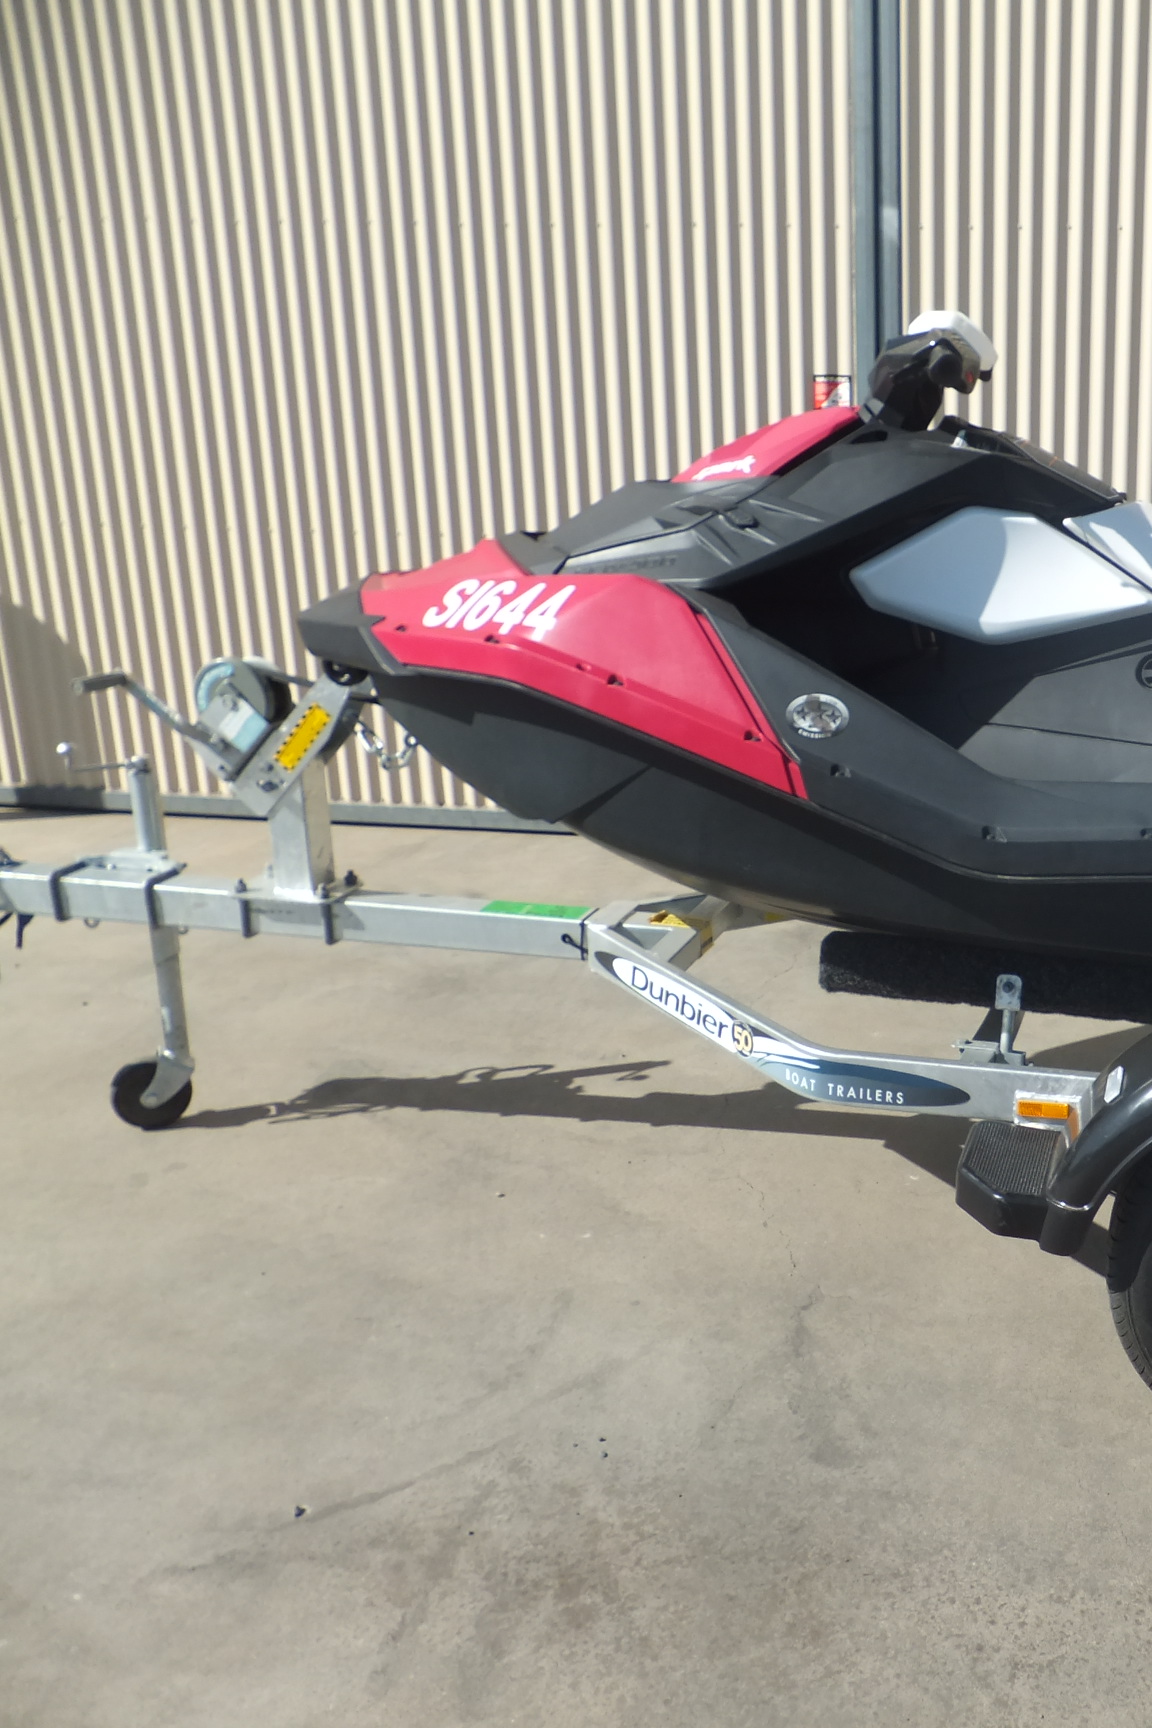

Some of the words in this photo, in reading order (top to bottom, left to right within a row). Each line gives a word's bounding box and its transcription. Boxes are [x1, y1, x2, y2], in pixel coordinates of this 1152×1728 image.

[631, 965, 729, 1038] Dunbier
[733, 1024, 751, 1053] 50
[785, 1068, 816, 1092] BOAT
[828, 1083, 905, 1105] TRAILERS
